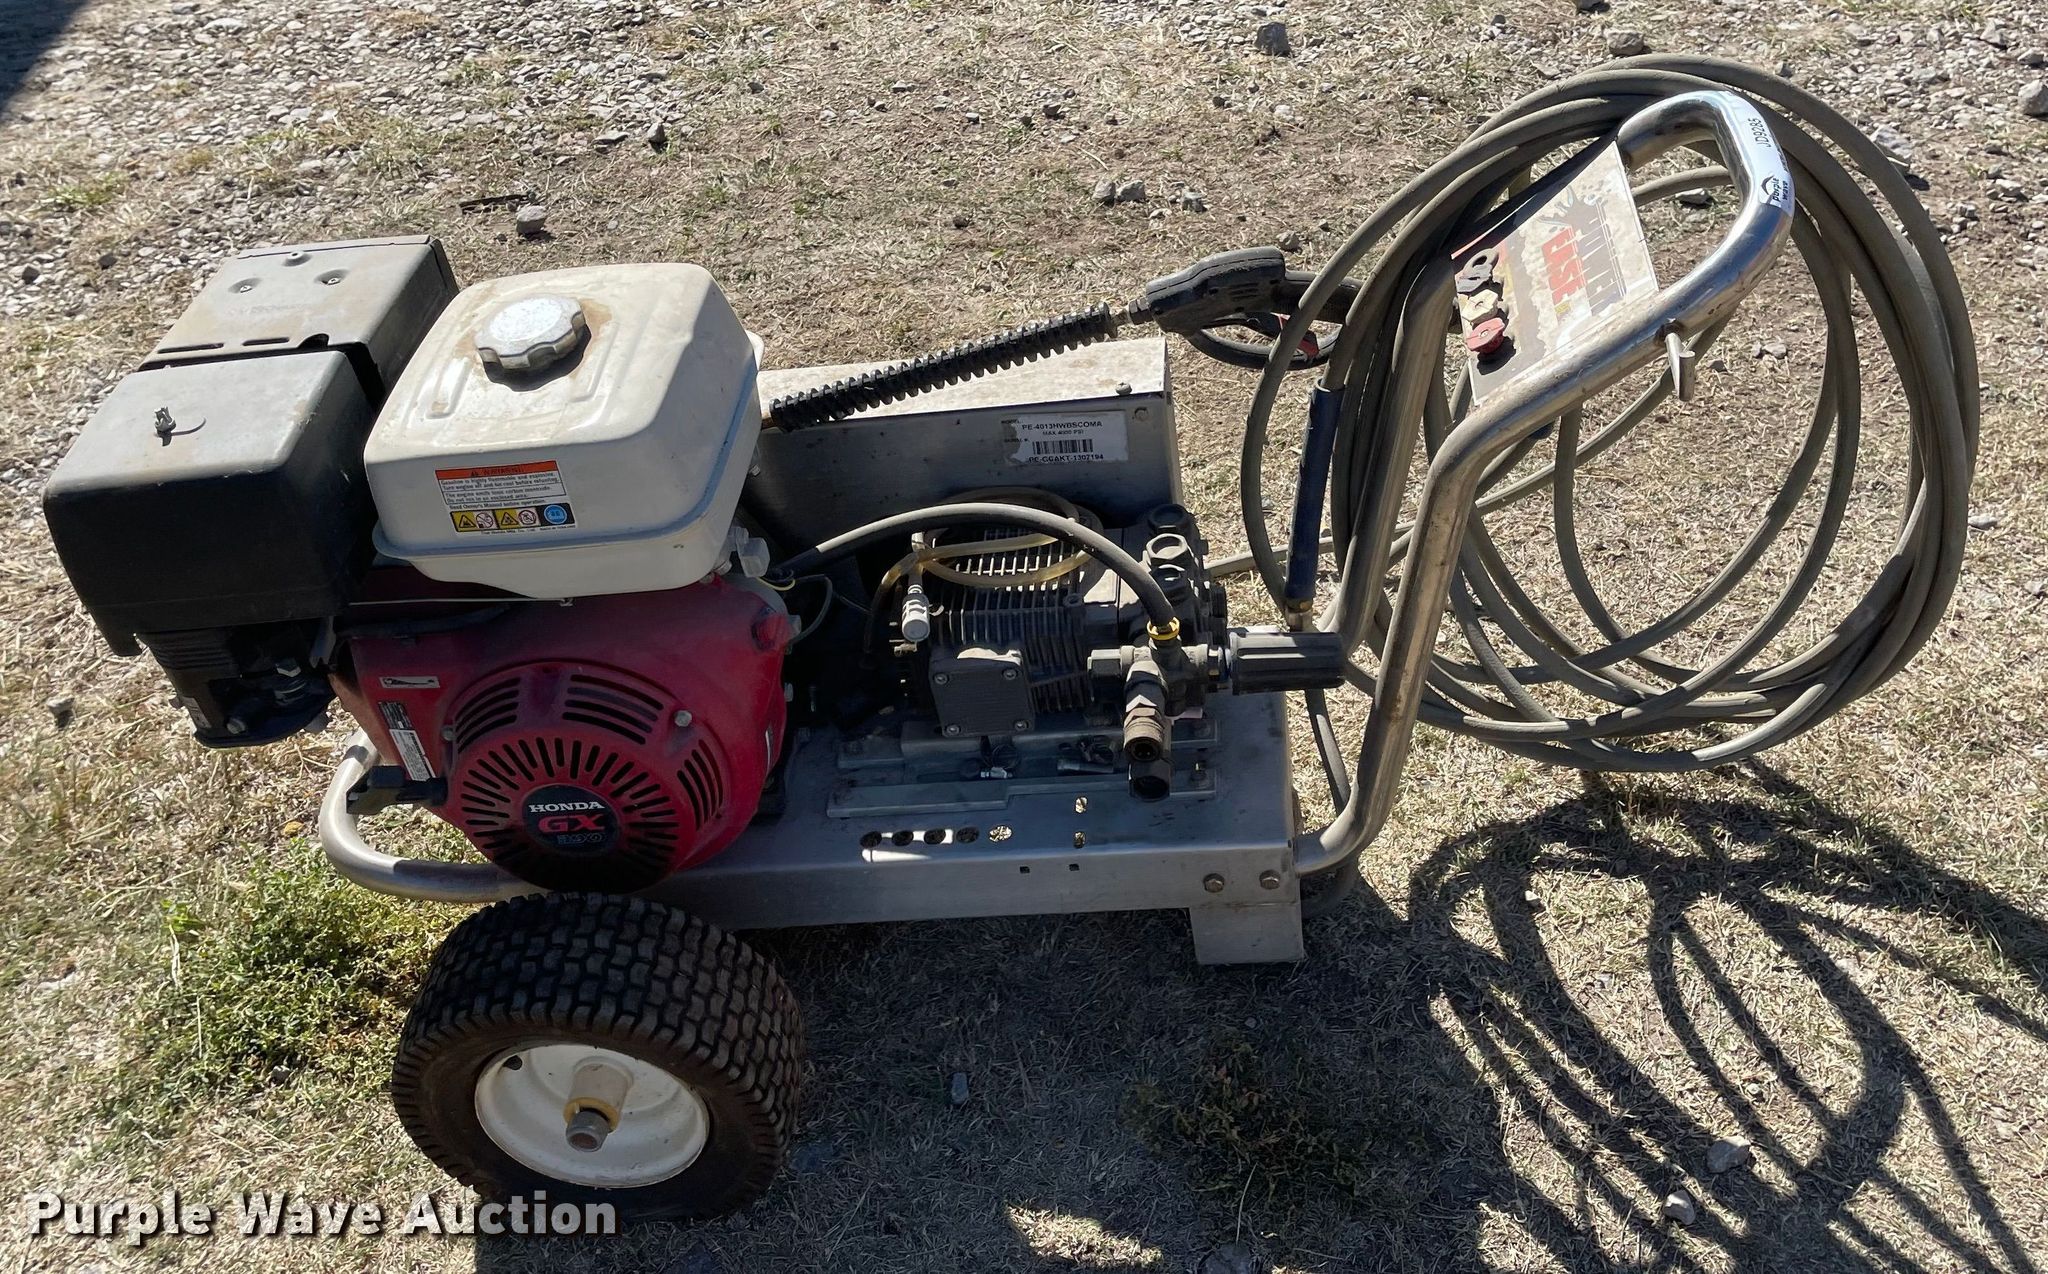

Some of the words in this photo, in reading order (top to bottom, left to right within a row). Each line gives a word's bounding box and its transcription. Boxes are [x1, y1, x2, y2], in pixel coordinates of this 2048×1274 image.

[1747, 117, 1771, 148] JD9285
[1541, 226, 1587, 306] EASE
[527, 800, 605, 813] HONDA
[537, 813, 605, 833] GX
